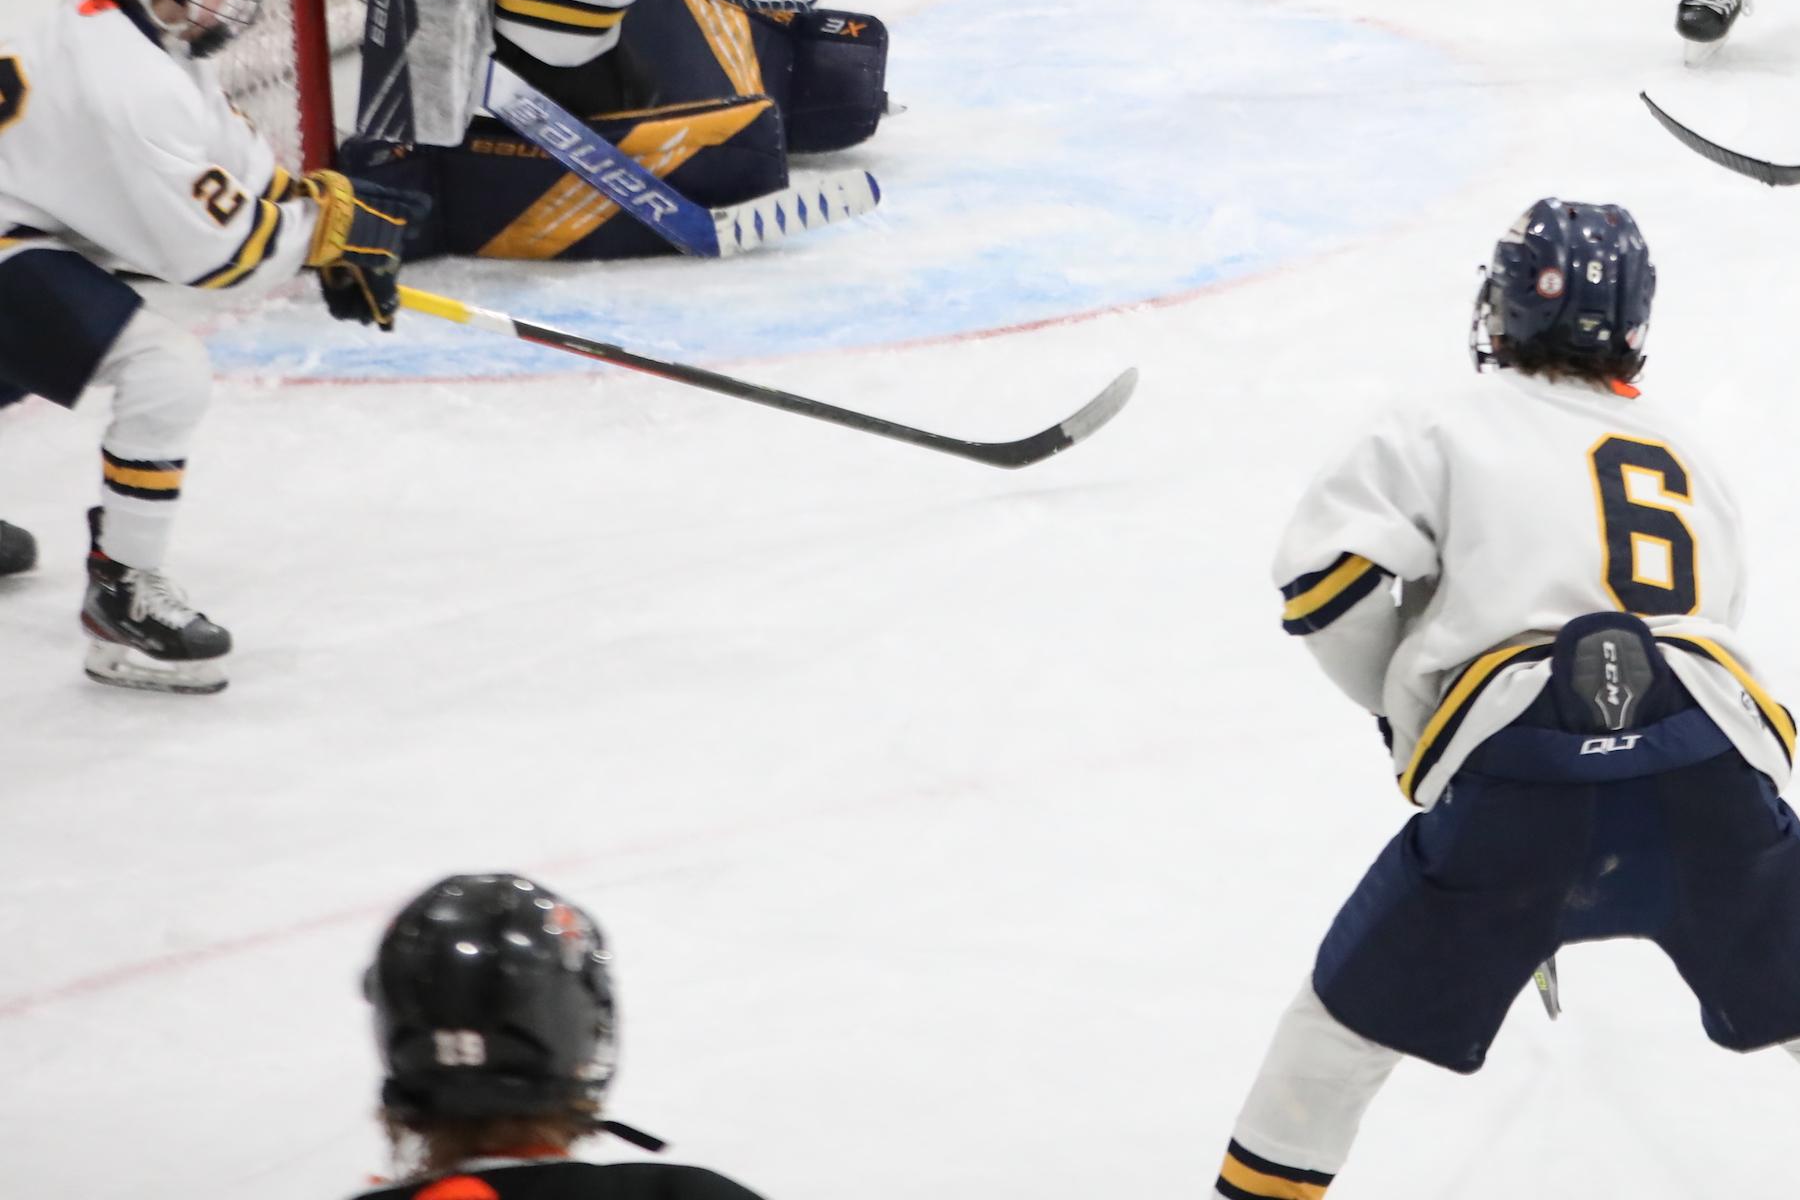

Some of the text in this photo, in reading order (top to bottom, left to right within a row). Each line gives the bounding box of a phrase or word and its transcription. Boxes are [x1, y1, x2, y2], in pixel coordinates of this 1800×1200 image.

[470, 139, 551, 161] BAU
[503, 93, 679, 223] BAUER
[192, 164, 246, 227] 2
[1586, 261, 1603, 284] 6
[1587, 432, 1701, 618] 6
[1602, 641, 1620, 706] CCM
